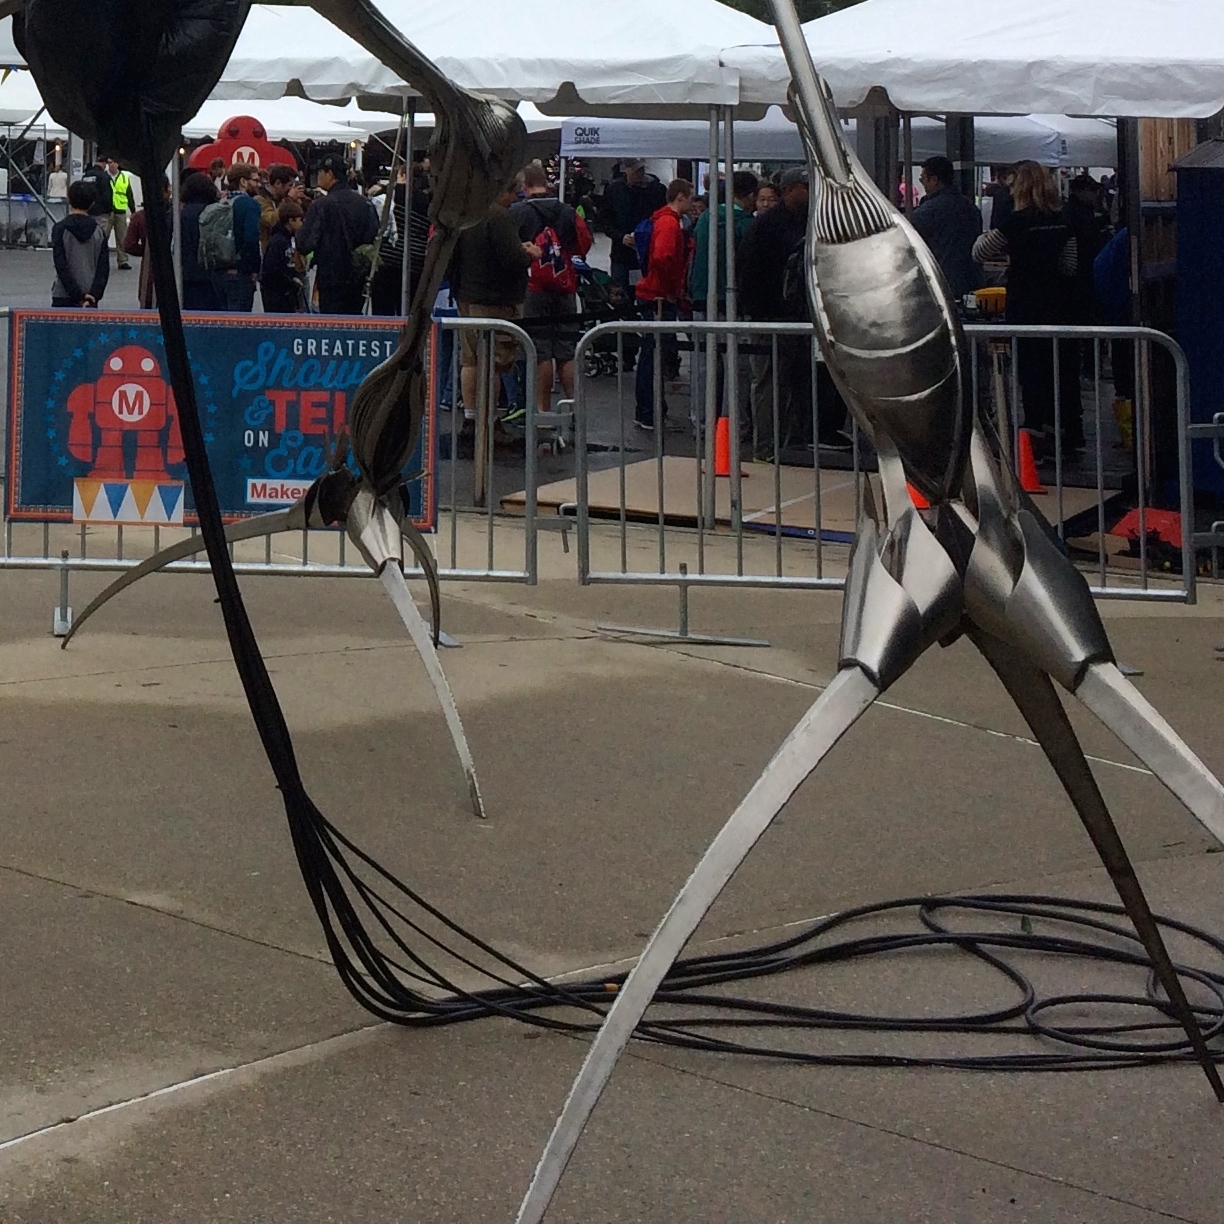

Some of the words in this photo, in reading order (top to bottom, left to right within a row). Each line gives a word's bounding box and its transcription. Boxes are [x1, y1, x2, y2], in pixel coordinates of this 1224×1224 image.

[575, 127, 600, 136] QUIK
[293, 338, 393, 357] GREATEST
[232, 341, 367, 398] Show
[118, 389, 144, 416] M
[265, 389, 351, 435] TEL
[244, 429, 269, 448] ON
